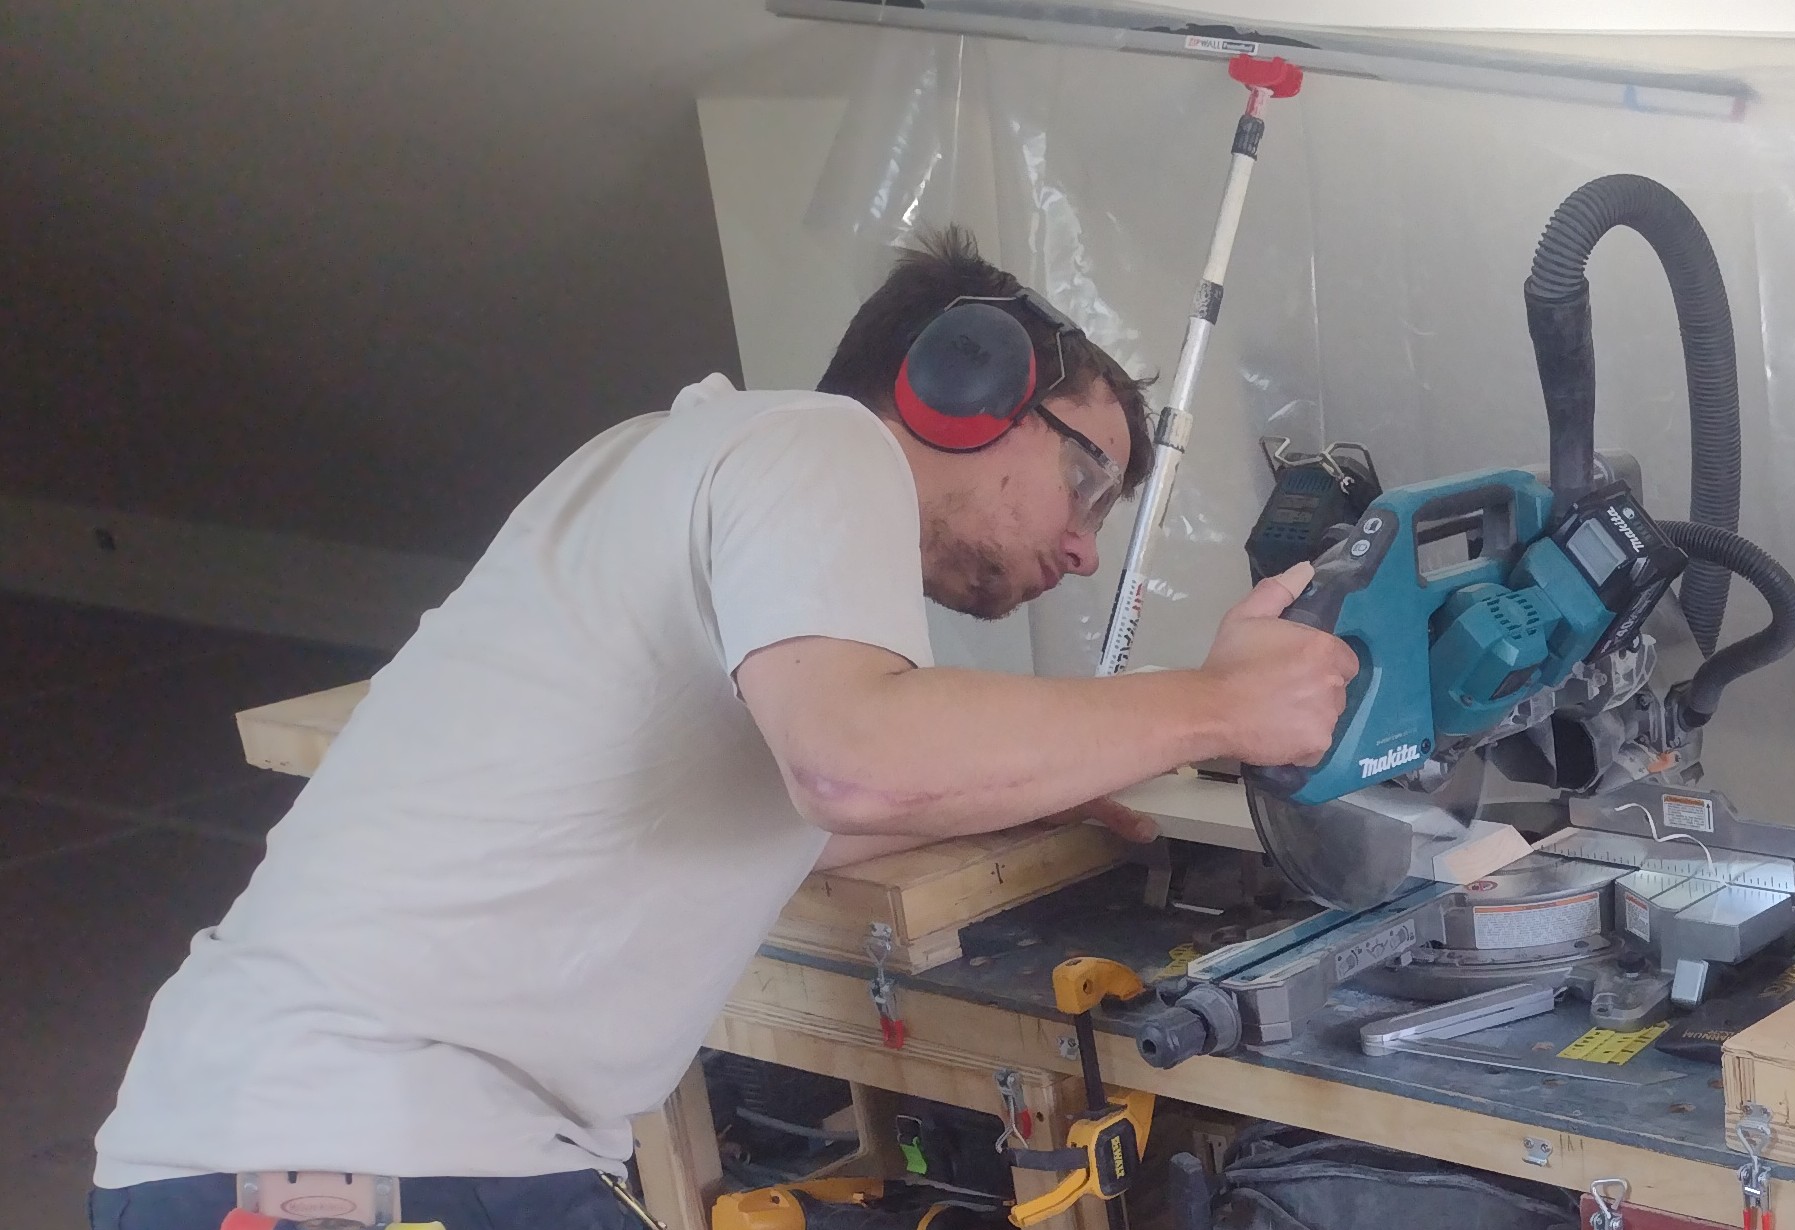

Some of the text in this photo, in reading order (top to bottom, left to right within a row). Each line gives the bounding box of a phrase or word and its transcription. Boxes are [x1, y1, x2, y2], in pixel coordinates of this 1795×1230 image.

[1606, 506, 1645, 553] makita
[1358, 743, 1421, 778] makita
[1110, 1135, 1126, 1180] DEWALT
